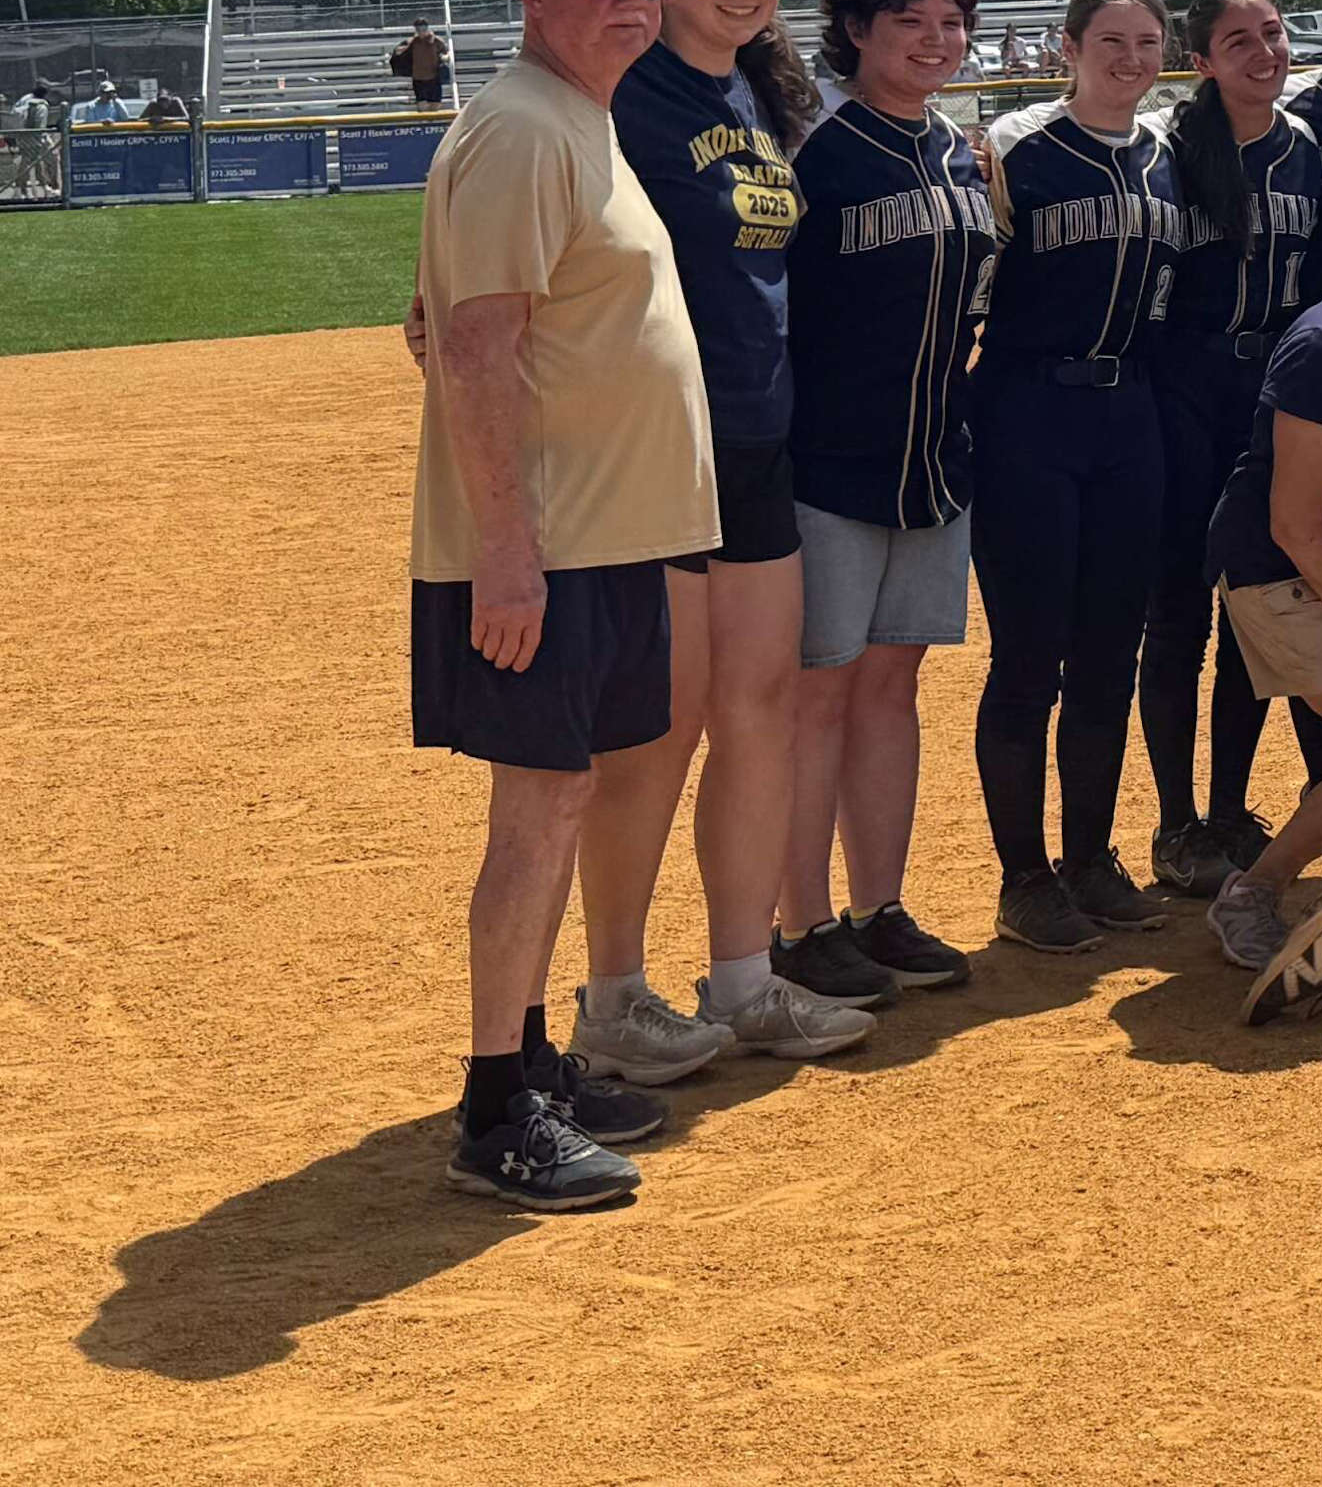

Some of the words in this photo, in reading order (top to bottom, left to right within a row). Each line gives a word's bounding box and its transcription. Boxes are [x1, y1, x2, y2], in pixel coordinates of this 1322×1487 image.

[747, 193, 789, 217] 2025
[840, 186, 955, 254] INDIAN
[1032, 193, 1142, 253] INDIAN
[1149, 264, 1174, 321] 2
